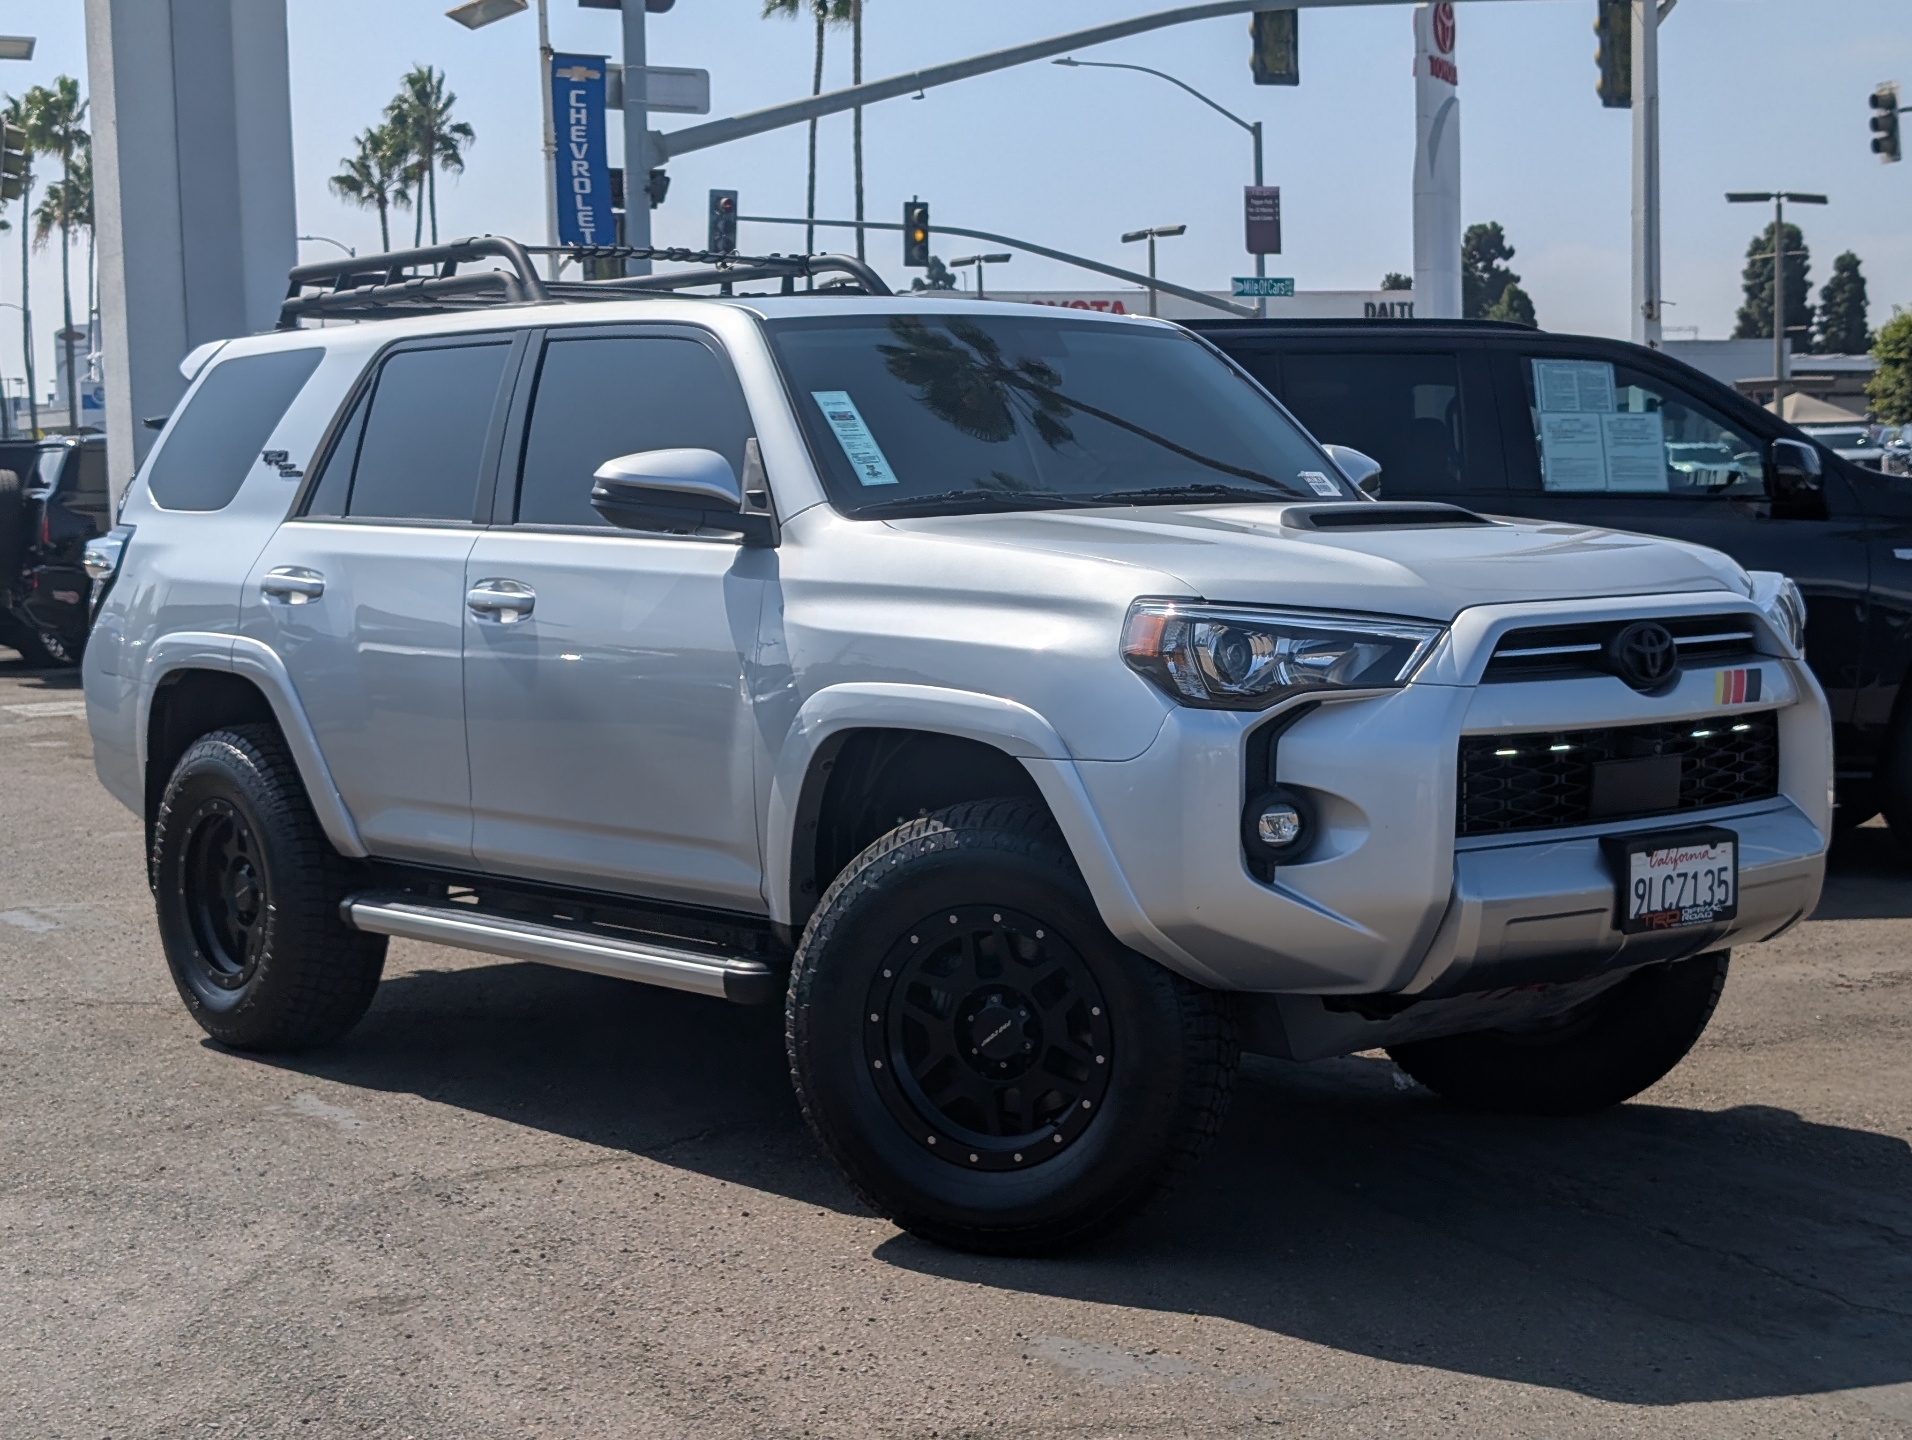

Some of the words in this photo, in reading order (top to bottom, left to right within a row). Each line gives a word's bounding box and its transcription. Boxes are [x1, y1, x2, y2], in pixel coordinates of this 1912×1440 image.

[569, 89, 596, 245] CHEVROLET
[1243, 279, 1259, 294] Mile
[1268, 279, 1285, 294] Cars
[1649, 849, 1716, 871] California
[1634, 866, 1729, 918] 9LCZ135
[1641, 909, 1680, 929] TRD
[1681, 911, 1713, 922] ROAD
